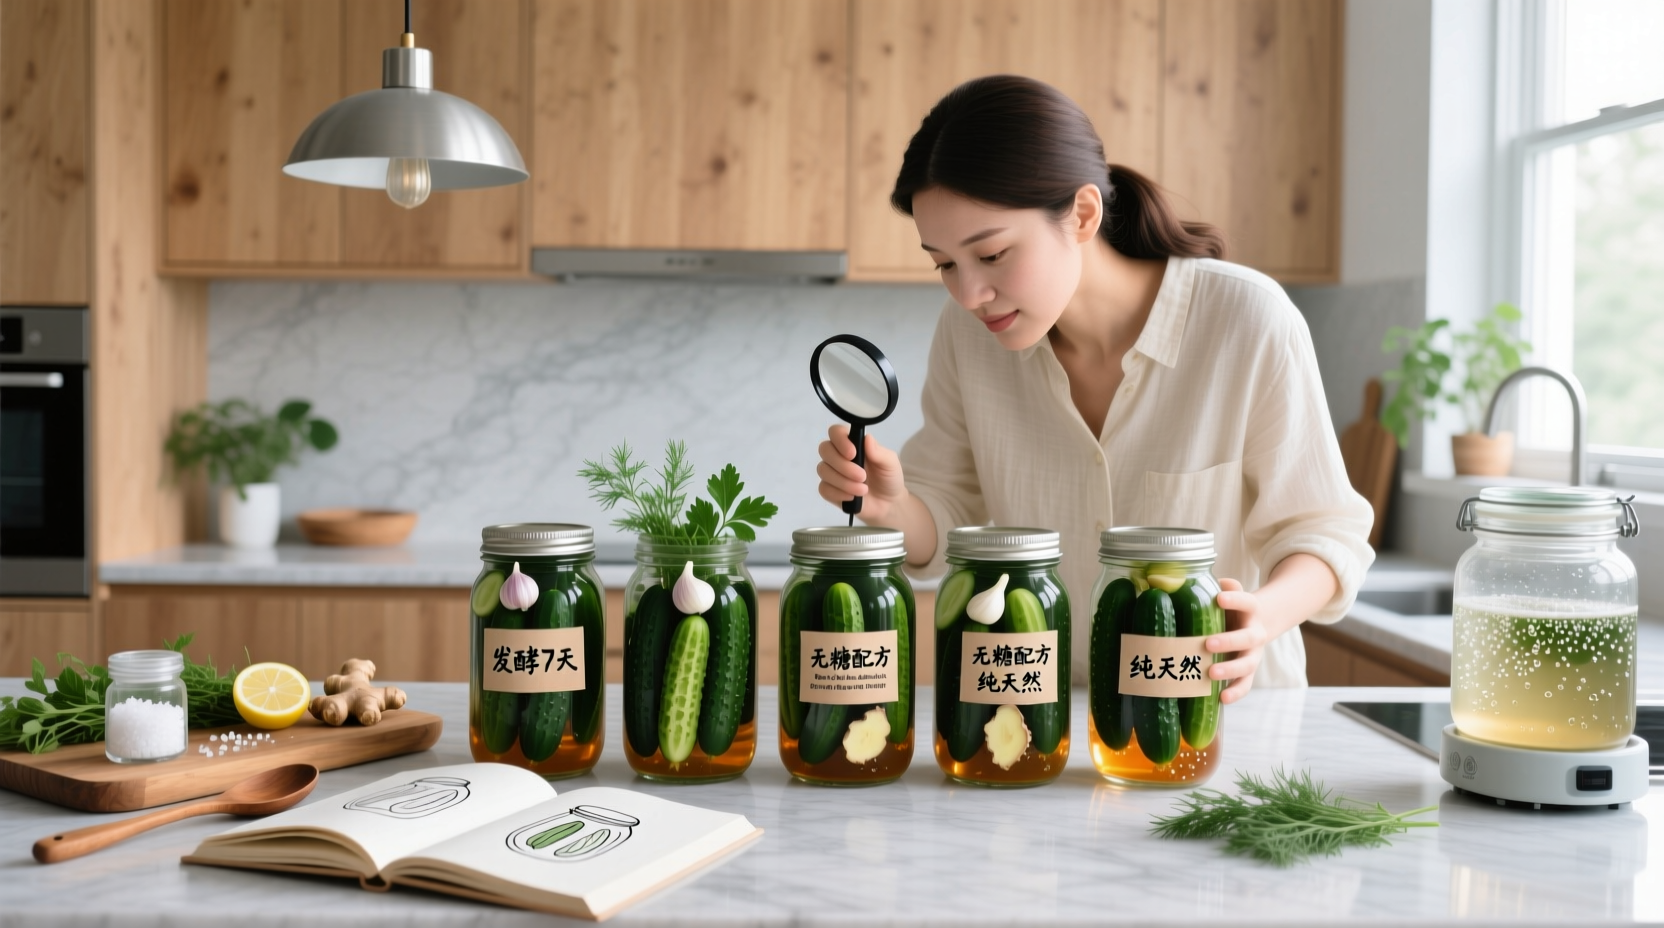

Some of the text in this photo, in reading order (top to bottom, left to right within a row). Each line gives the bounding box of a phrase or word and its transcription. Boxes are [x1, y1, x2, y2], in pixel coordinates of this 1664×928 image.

[492, 645, 578, 676] 发酵7天
[810, 645, 891, 671] 无糖配方
[971, 643, 1052, 668] 无糖配方
[1129, 654, 1202, 682] 纯天然
[976, 670, 1043, 694] 纯天然
